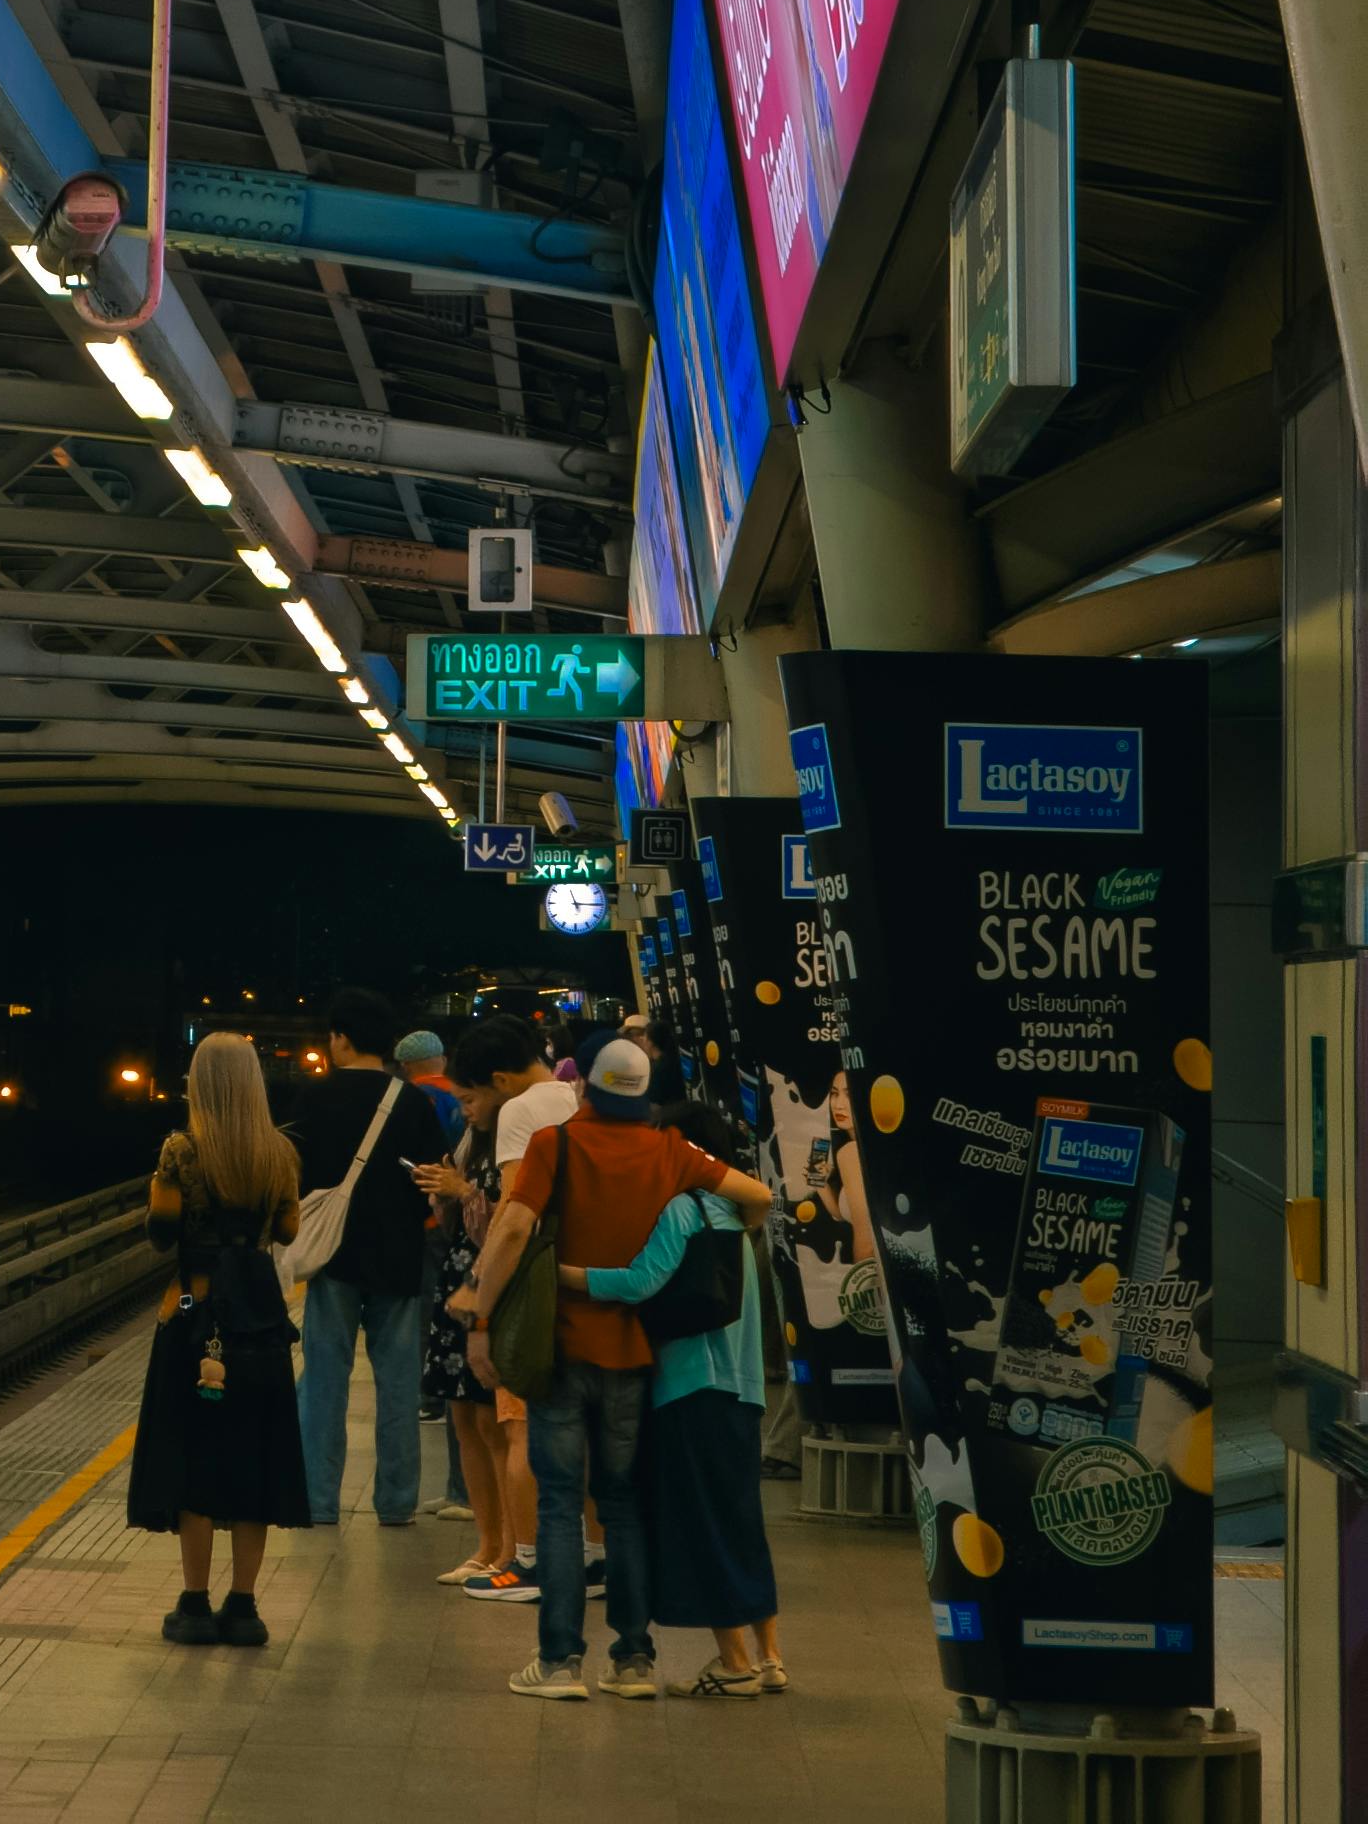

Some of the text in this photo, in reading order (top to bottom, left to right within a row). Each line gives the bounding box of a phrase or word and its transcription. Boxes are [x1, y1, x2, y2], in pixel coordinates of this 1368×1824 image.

[431, 642, 541, 674] ทางออก
[435, 679, 538, 711] EXIT
[958, 739, 1132, 814] Lactasoy
[1038, 806, 1081, 816] SINCE
[978, 868, 1160, 910] BLACK Vegan
[1110, 888, 1157, 906] Friendly
[976, 914, 1157, 980] SESAME
[1007, 992, 1127, 1017] ประโยชน์ทุกคำ
[1020, 1017, 1114, 1039] หอมงาดำ
[996, 1039, 1139, 1073] อร่อยมาก
[933, 1098, 1033, 1152] แคลเซียมสูง
[1041, 1102, 1086, 1116] SOYMILK
[1045, 1126, 1134, 1169] Lactasoy
[1035, 1188, 1088, 1215] BLACK
[1027, 1213, 1123, 1259] SESAME
[1133, 1337, 1155, 1359] 15
[1033, 1472, 1170, 1528] PLANT BASED
[1034, 1628, 1148, 1643] LactasoyShop.com
